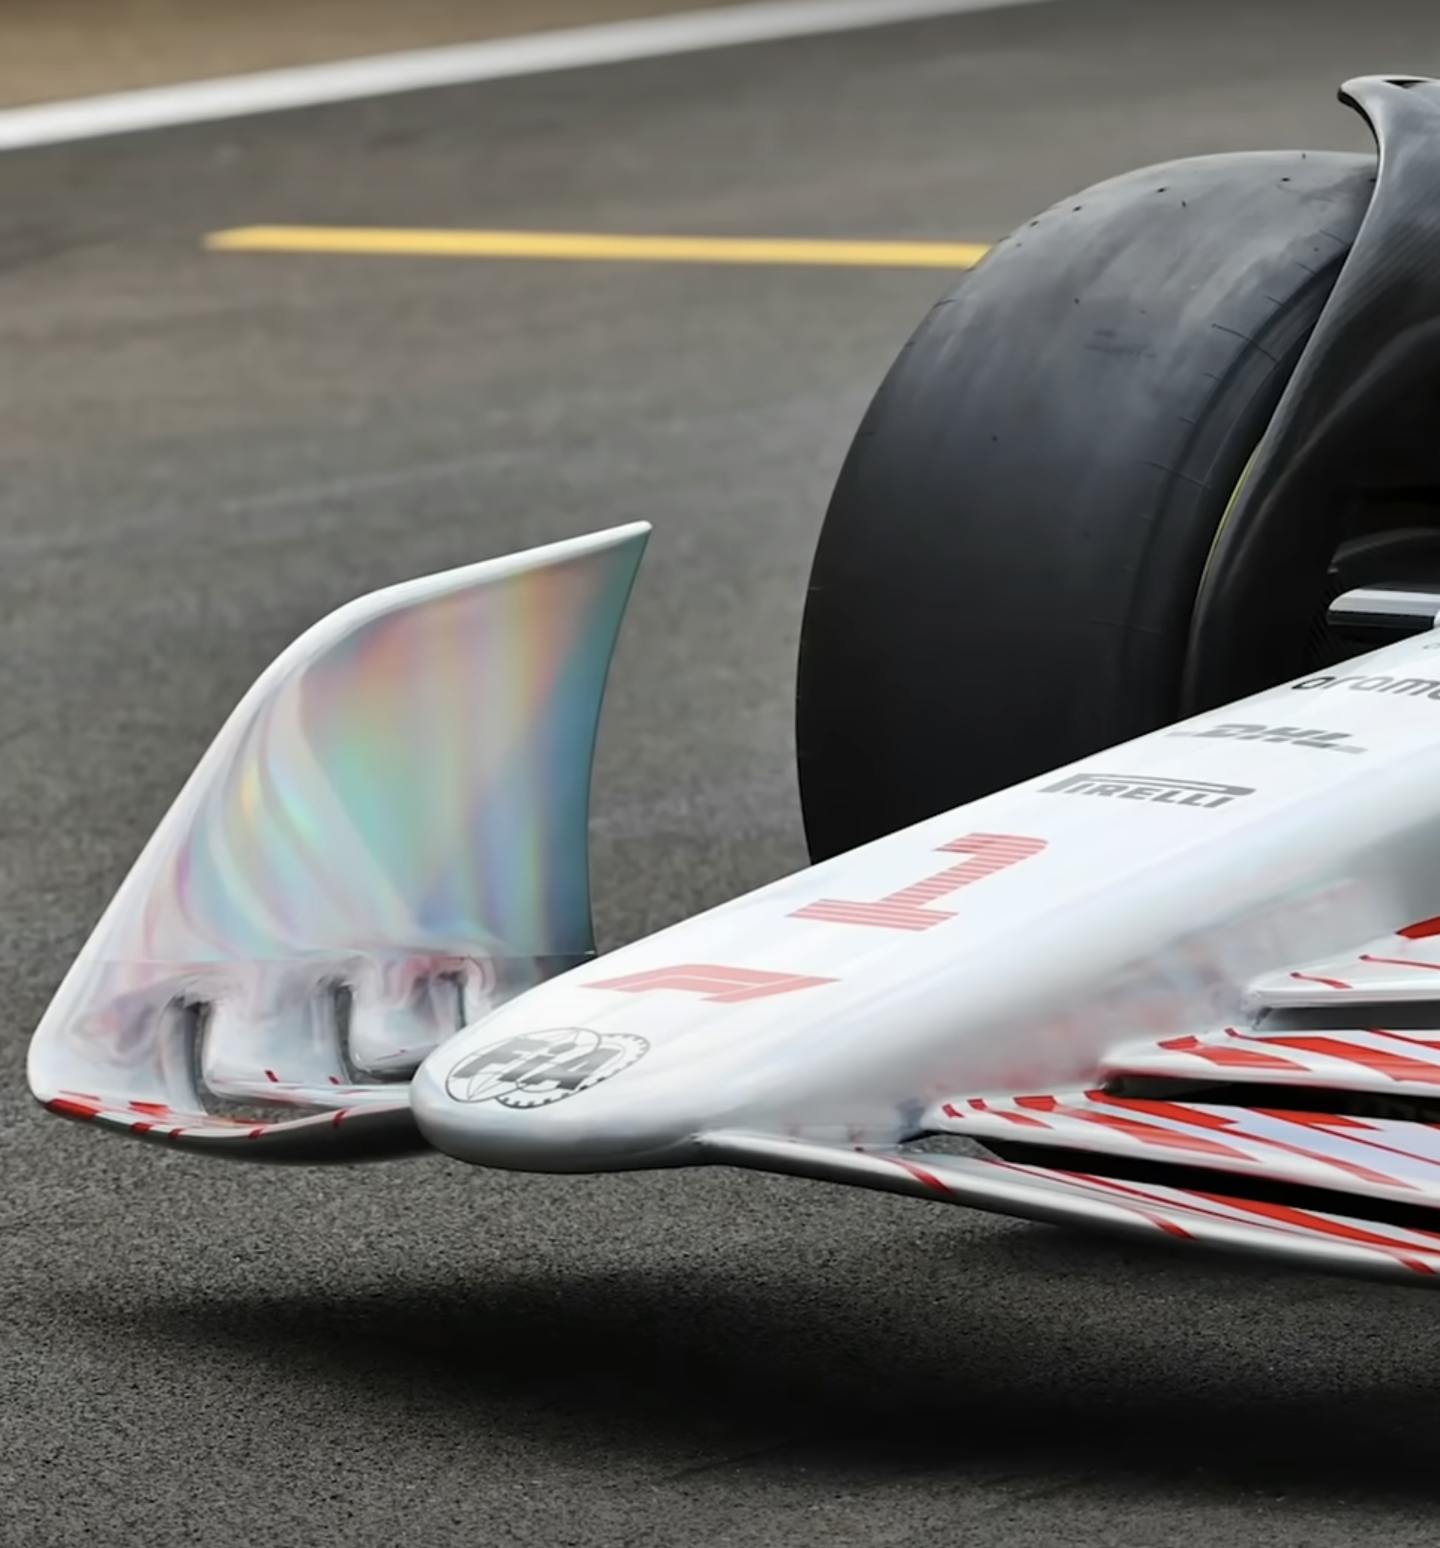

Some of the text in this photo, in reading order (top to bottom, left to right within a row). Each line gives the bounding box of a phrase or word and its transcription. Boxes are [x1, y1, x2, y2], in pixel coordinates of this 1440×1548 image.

[1190, 723, 1357, 750] DHL
[1037, 773, 1257, 808] PIRELLI
[786, 832, 1049, 932] 1
